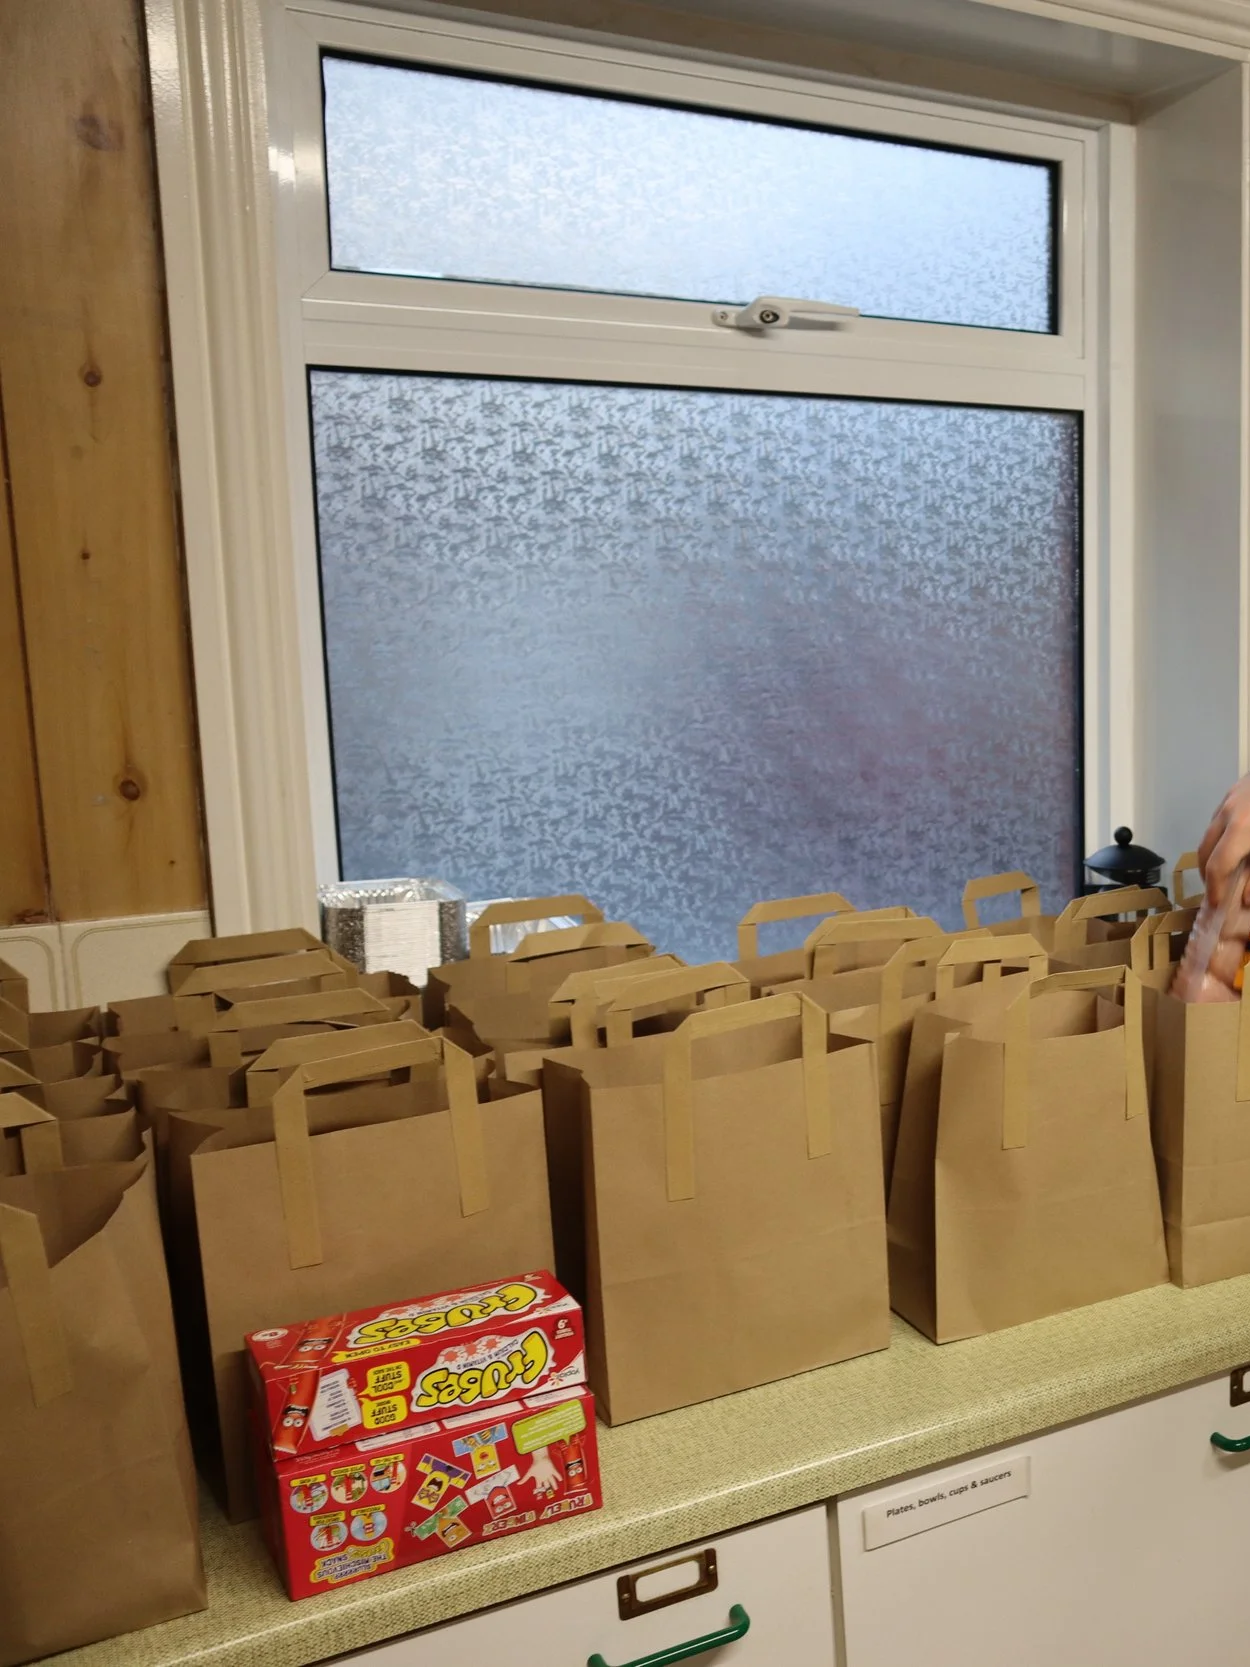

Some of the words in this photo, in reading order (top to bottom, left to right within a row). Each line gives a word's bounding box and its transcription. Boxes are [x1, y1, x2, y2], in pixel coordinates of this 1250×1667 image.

[374, 1371, 402, 1384] STUFF
[372, 1381, 394, 1393] COOL
[371, 1404, 397, 1418] STUFF
[374, 1413, 396, 1425] GOOD
[886, 1503, 917, 1518] Plates,
[918, 1492, 947, 1507] bowls,
[949, 1485, 968, 1497] cups
[970, 1480, 978, 1489] &
[980, 1470, 1012, 1487] saucers
